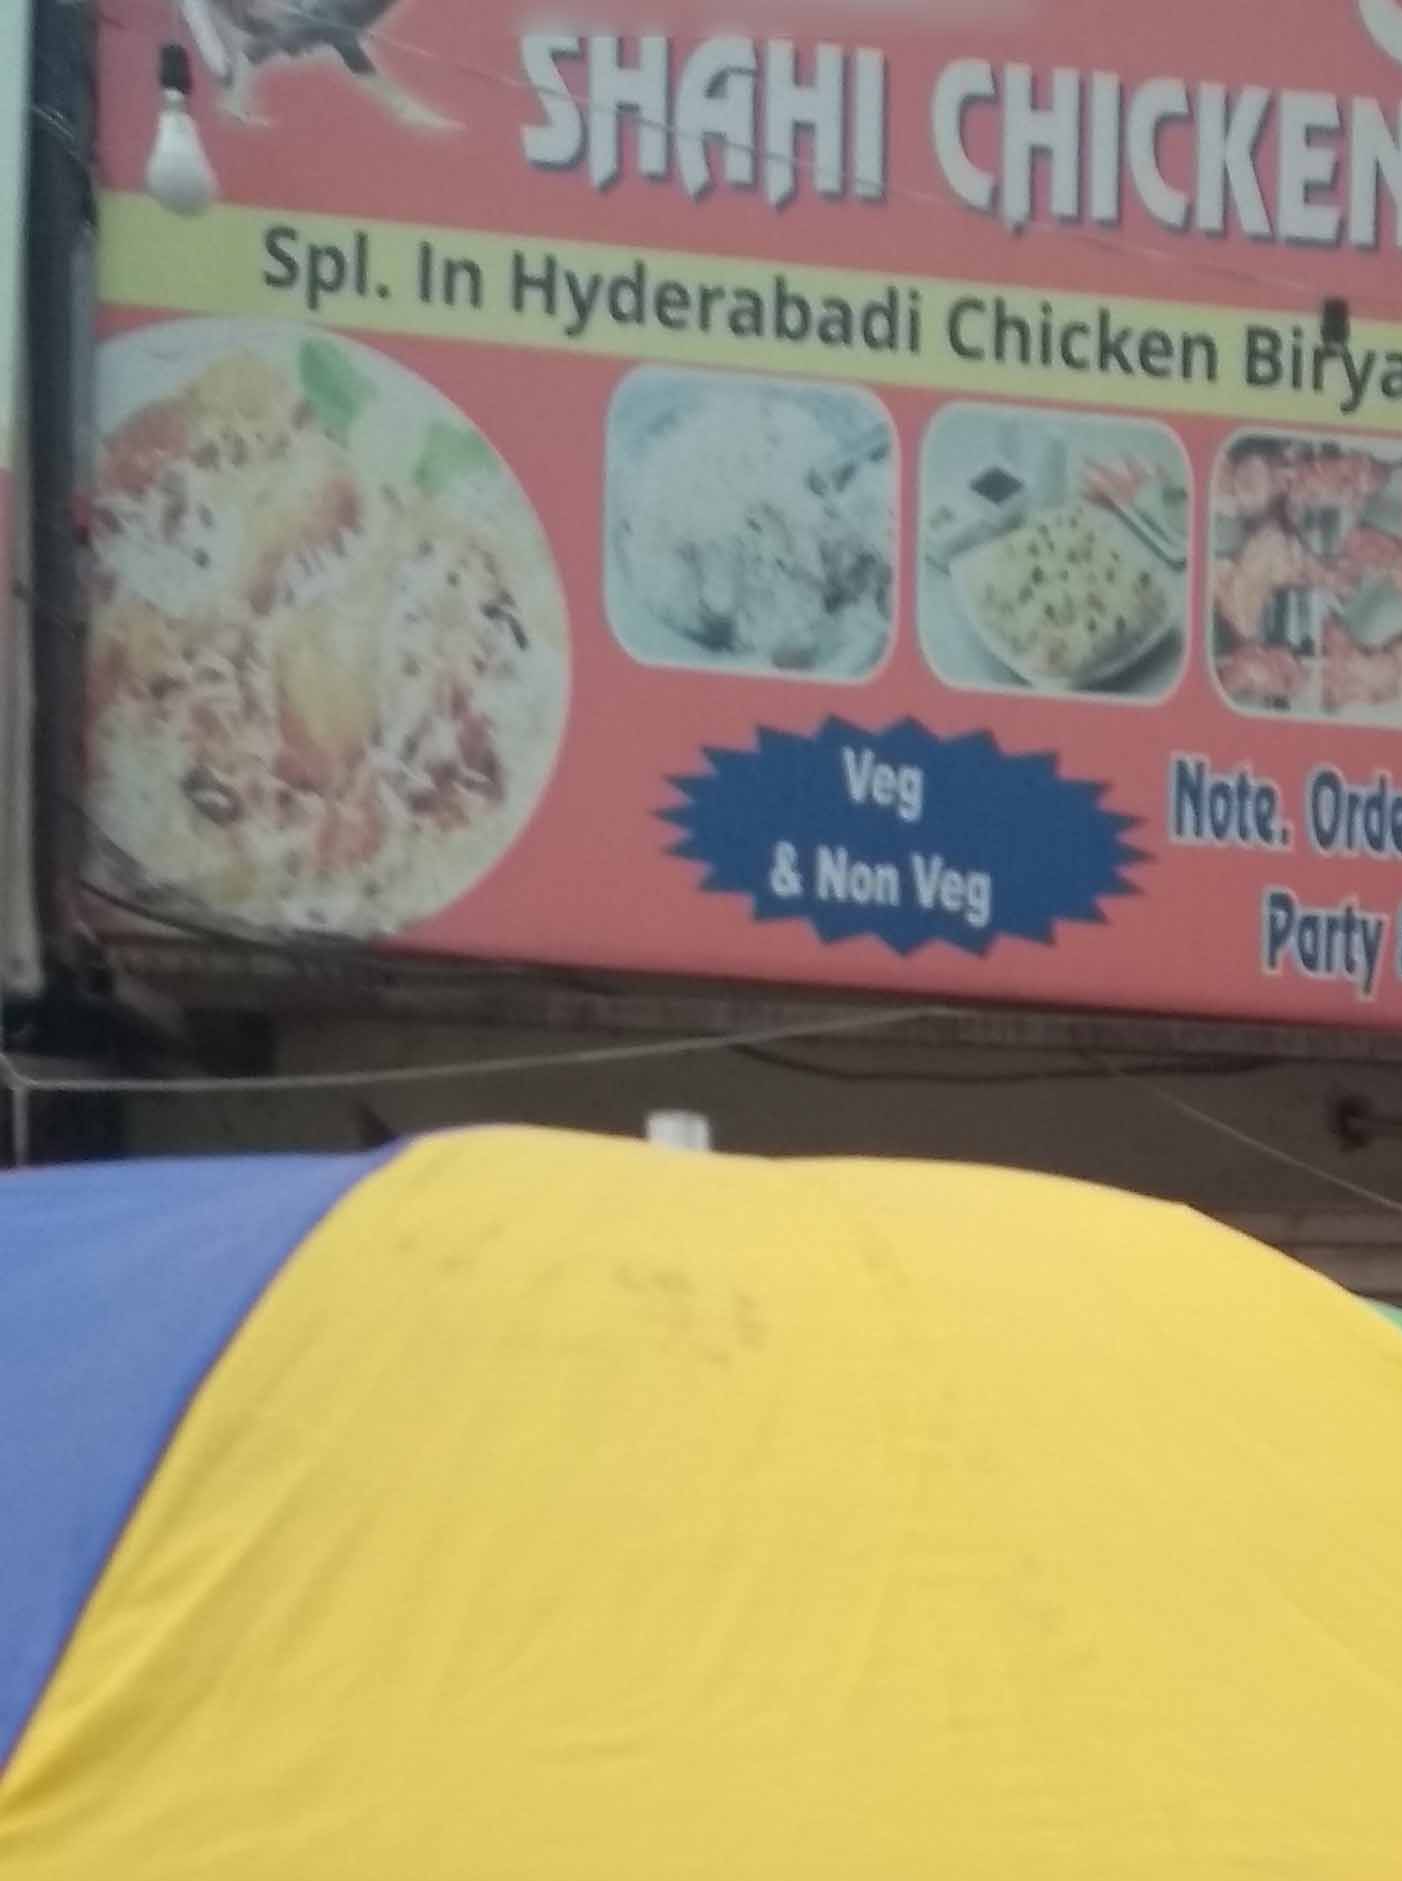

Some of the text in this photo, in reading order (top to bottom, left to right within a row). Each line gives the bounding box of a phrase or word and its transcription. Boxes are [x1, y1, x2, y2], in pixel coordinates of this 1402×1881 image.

[519, 34, 887, 207] SHAHI
[262, 226, 391, 310] Spl.
[418, 240, 484, 310] In
[509, 252, 922, 354] Hyderabadi
[946, 294, 1220, 384] Chicken
[842, 746, 926, 822] Veg
[1168, 752, 1292, 848] Note.
[768, 841, 994, 929] & Non Veg
[1260, 888, 1385, 1000] Party
